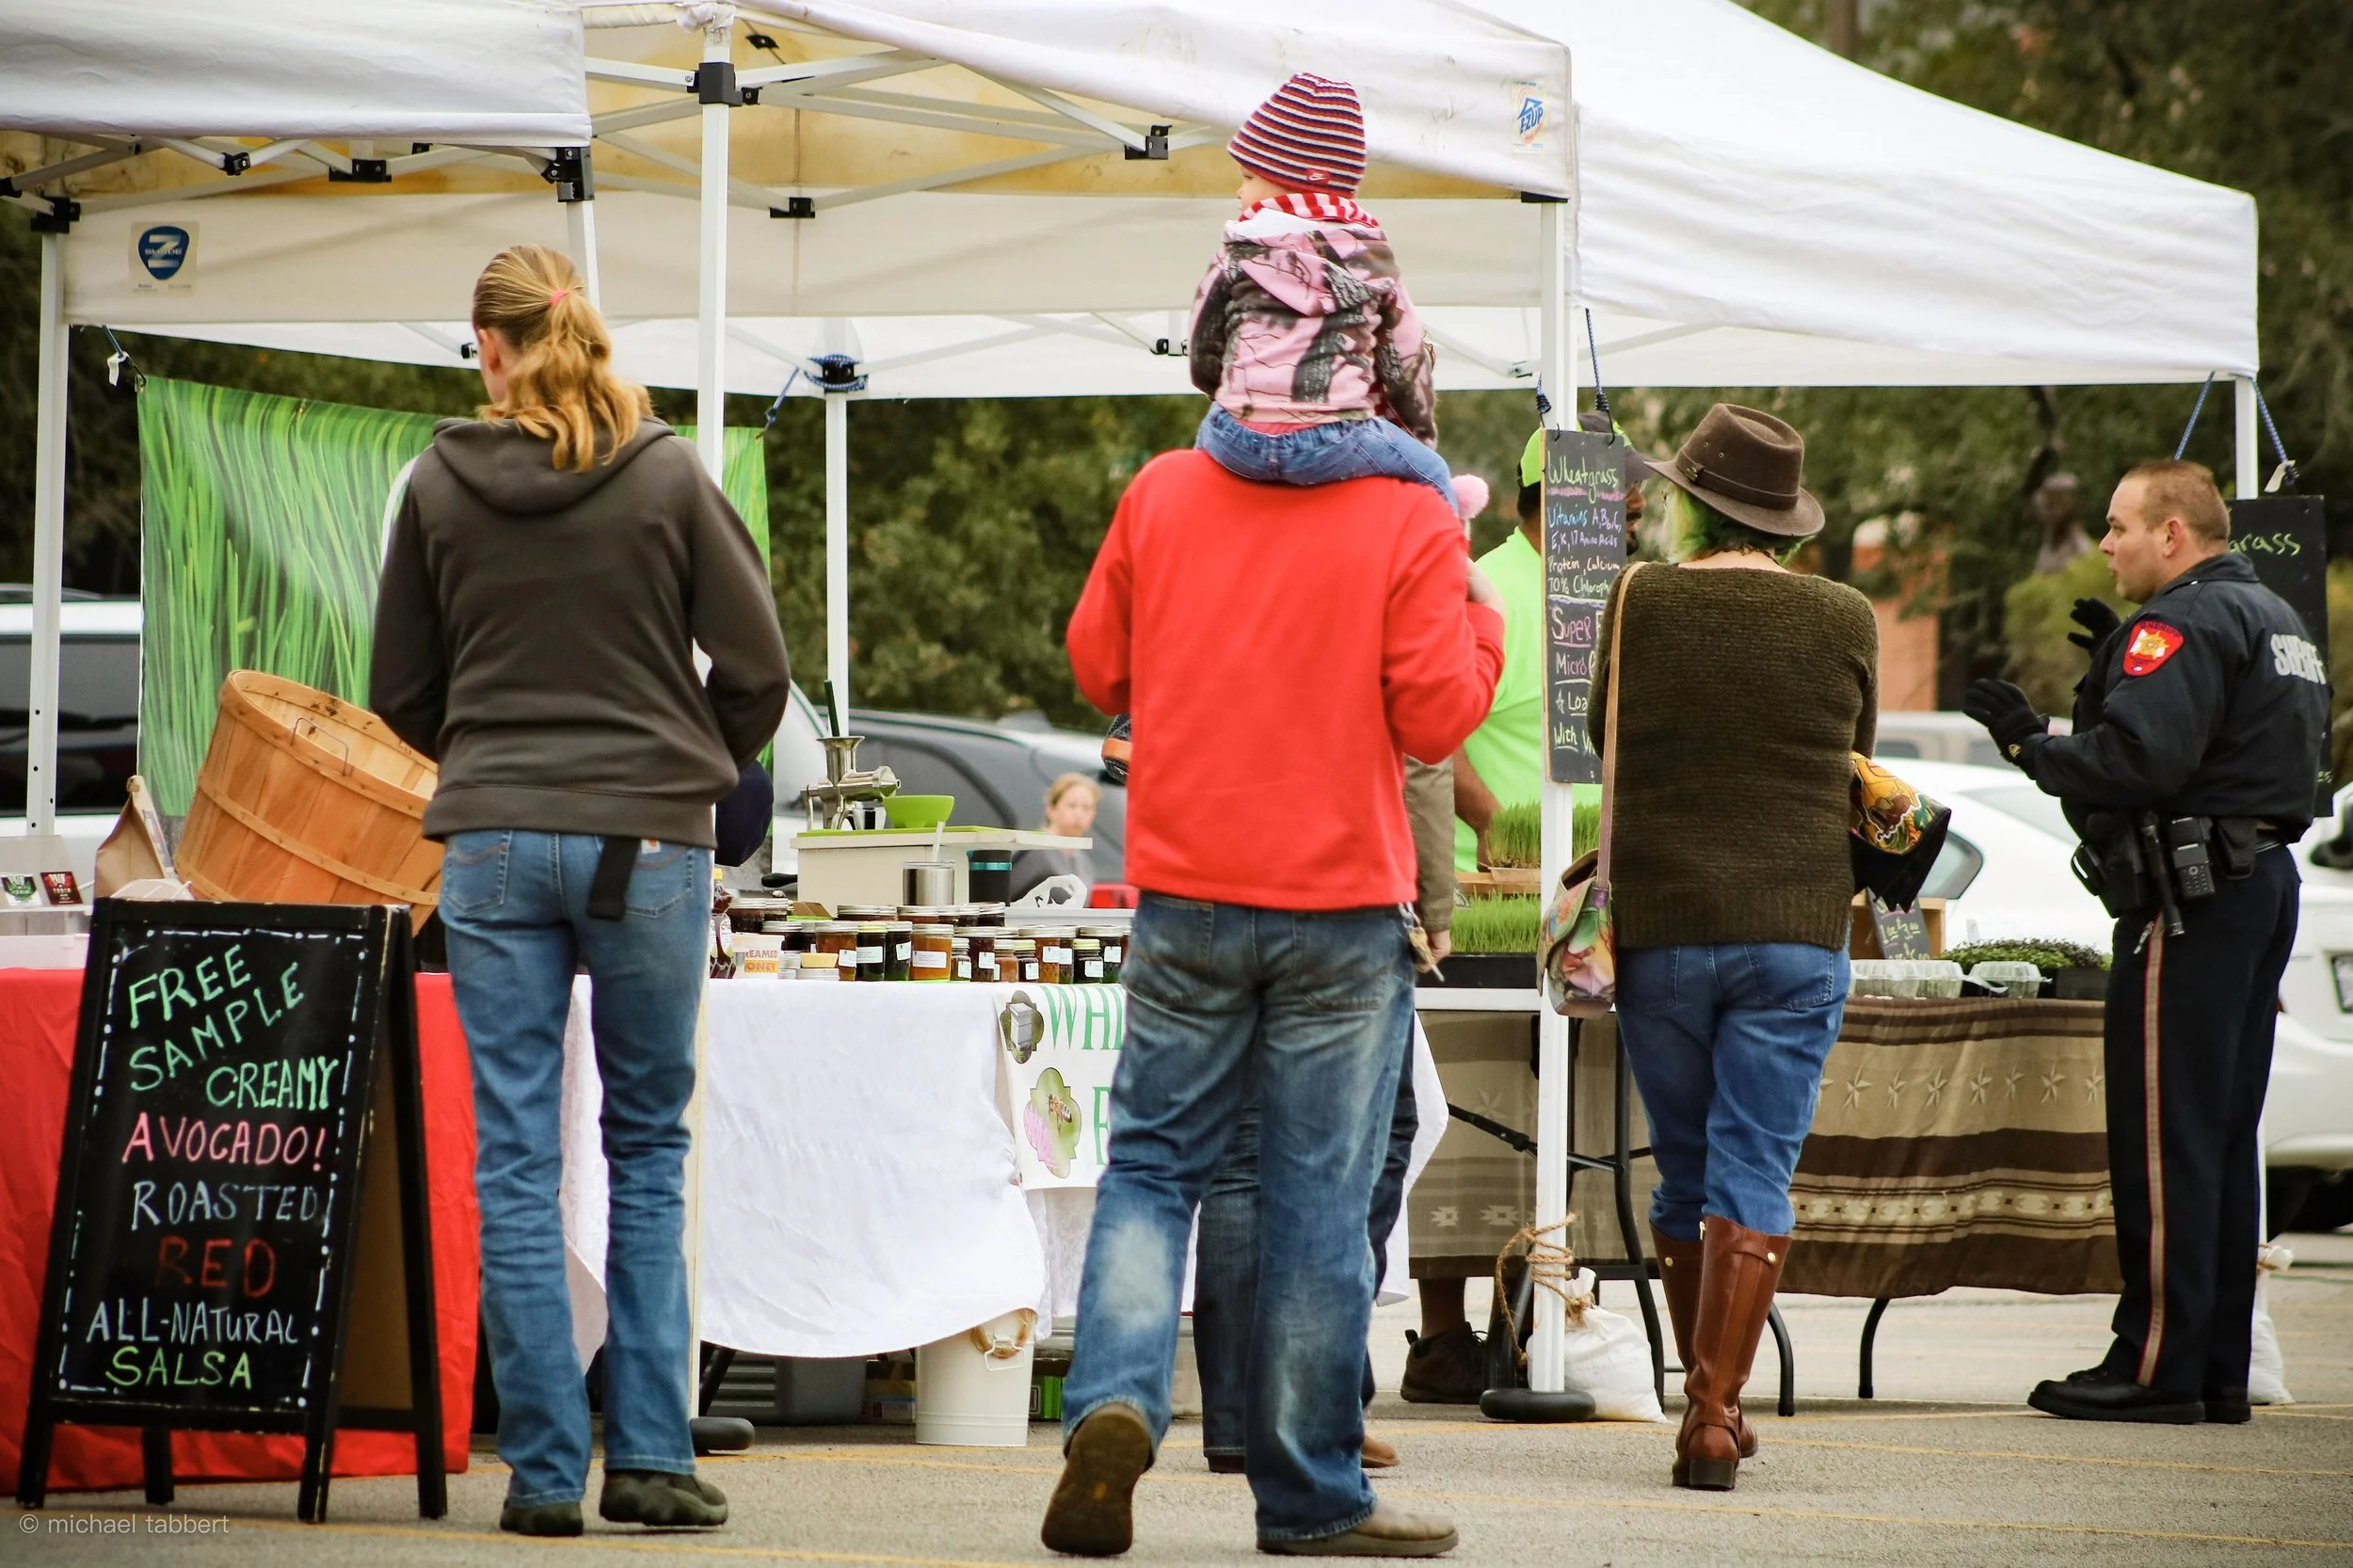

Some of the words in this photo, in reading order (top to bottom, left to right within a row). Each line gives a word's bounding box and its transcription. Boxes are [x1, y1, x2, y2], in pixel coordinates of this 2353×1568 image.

[1547, 450, 1619, 504] Wheatgrass
[129, 944, 251, 1029] FREE
[130, 962, 304, 1091] SAMPLE
[206, 1056, 339, 1111] CREAMY
[121, 1112, 326, 1172] AVOCADO!
[132, 1180, 318, 1231] ROASTED
[154, 1236, 276, 1298] RED
[86, 1297, 298, 1345] ALL-NATURAL
[105, 1346, 251, 1390] SALSA
